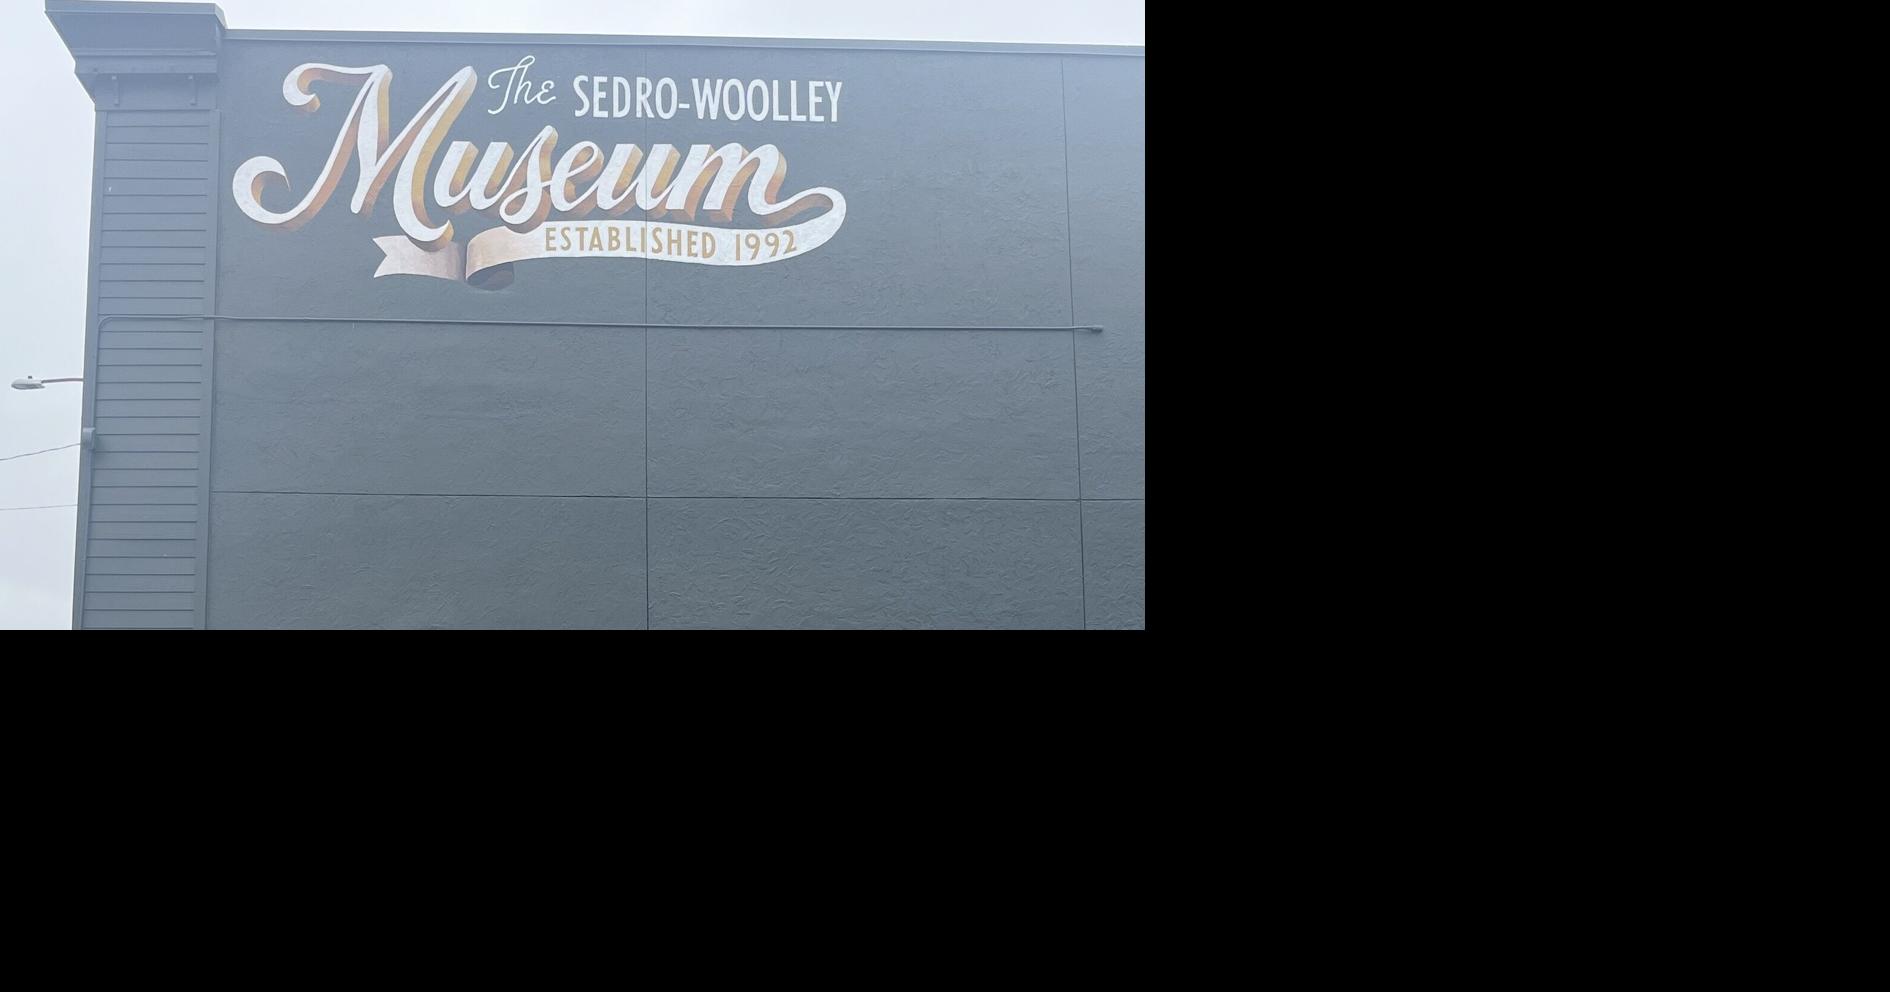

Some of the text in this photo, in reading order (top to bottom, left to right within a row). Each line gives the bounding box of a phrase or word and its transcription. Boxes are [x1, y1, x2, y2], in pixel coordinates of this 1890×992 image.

[487, 55, 843, 123] The SEDRO-WOOLLEY
[232, 62, 847, 242] Museum
[544, 226, 798, 261] ESTABLISHED 1992
